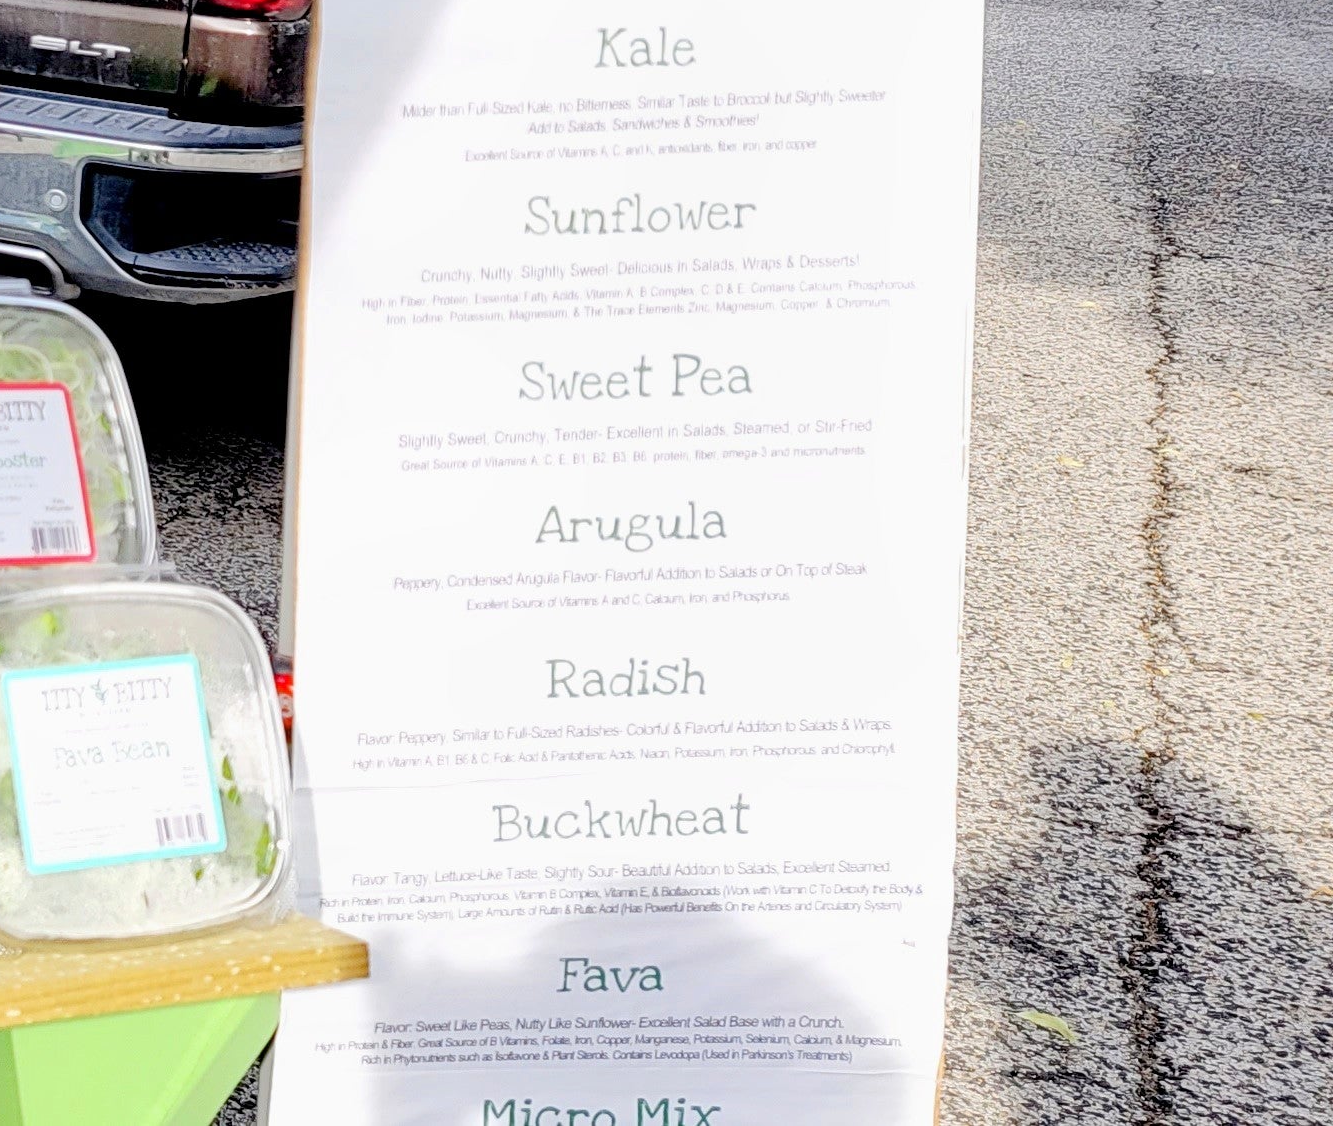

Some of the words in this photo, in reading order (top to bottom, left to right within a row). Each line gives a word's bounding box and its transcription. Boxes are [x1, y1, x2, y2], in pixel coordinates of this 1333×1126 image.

[30, 34, 131, 59] SLT
[595, 27, 697, 69] Kale
[524, 193, 757, 236] Sunflower
[519, 354, 654, 402] Sweet
[671, 353, 753, 398] Pea
[534, 501, 727, 552] Arugula
[546, 656, 707, 699] Radish
[492, 792, 751, 843] Buckwheat
[556, 957, 665, 994] Fava
[416, 1020, 450, 1033] Sweet
[454, 1020, 477, 1032] Like
[515, 1018, 544, 1032] Nutty
[548, 1017, 572, 1030] Like
[639, 1016, 690, 1029] Excellent
[694, 1015, 727, 1028] Salad
[729, 1015, 758, 1028] Base
[762, 1015, 785, 1028] with
[482, 1097, 616, 1126] Micro
[633, 1097, 722, 1126] Mix
